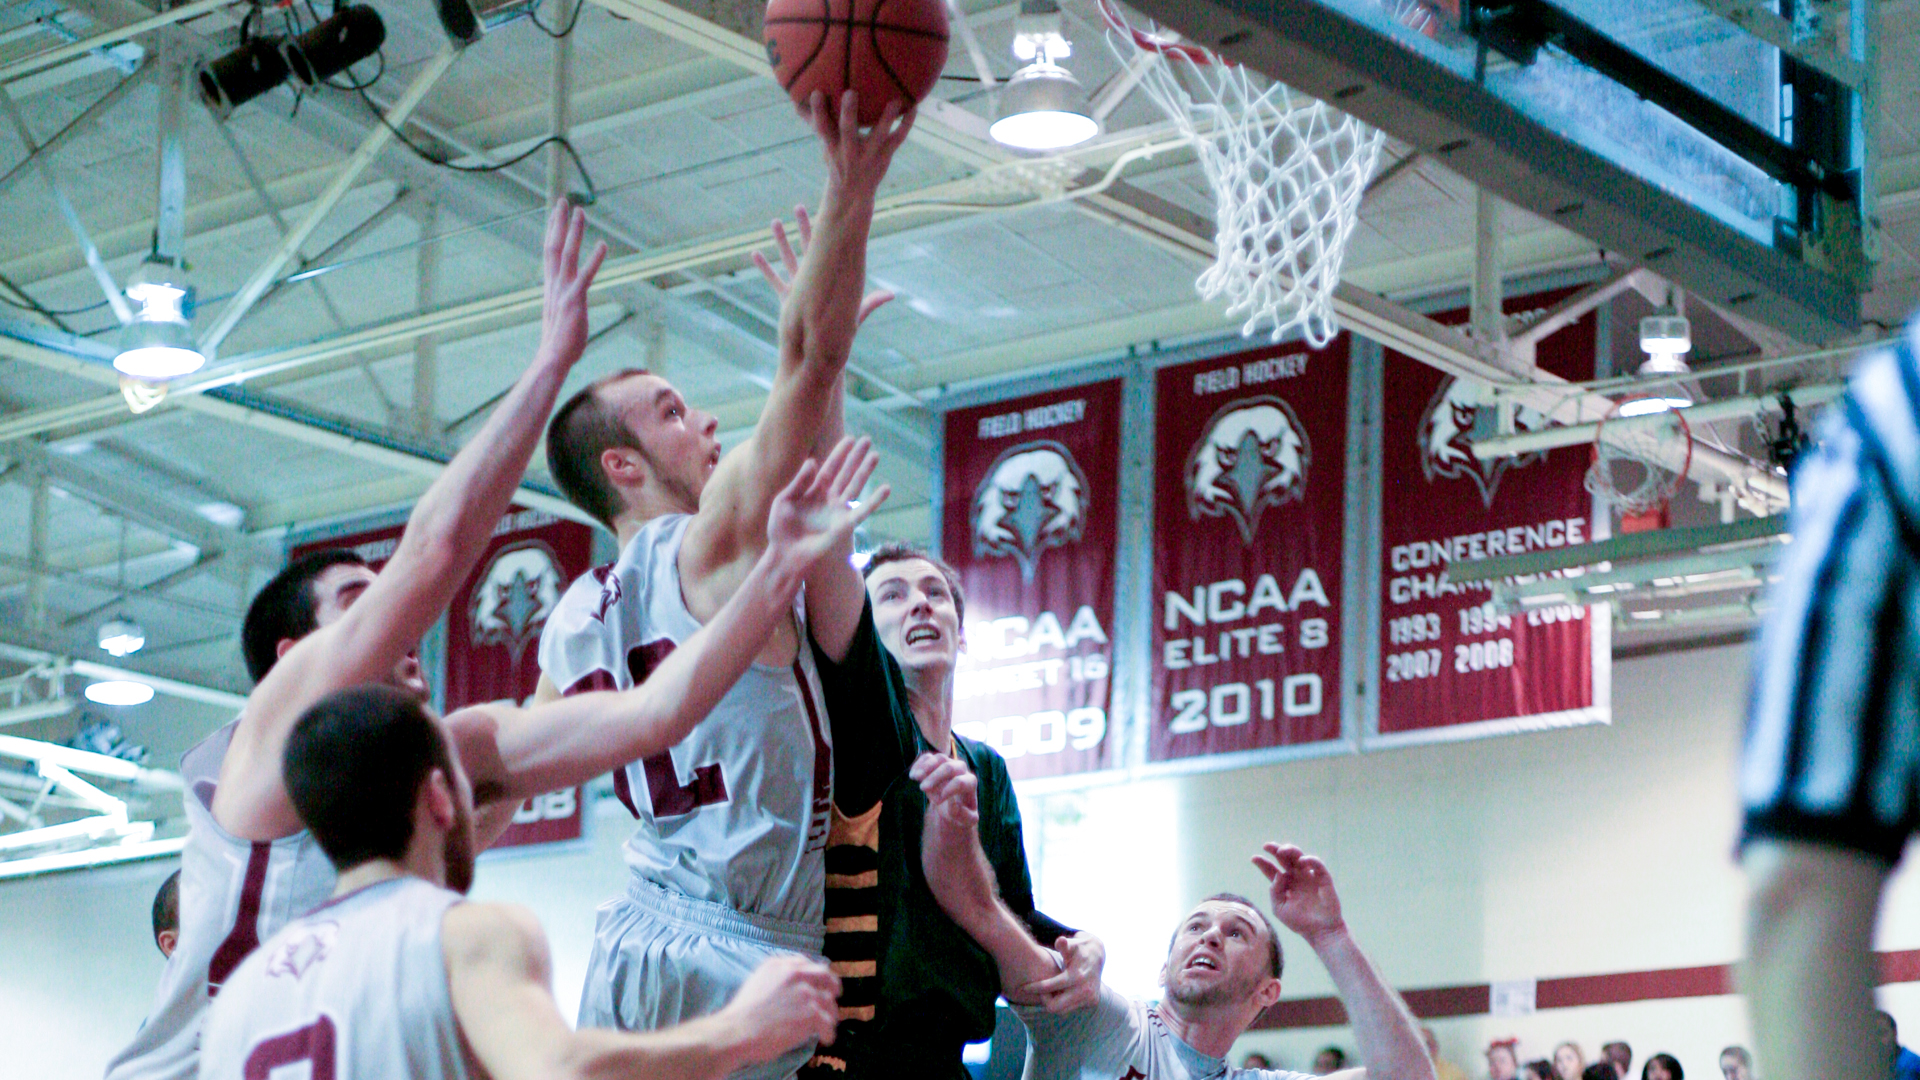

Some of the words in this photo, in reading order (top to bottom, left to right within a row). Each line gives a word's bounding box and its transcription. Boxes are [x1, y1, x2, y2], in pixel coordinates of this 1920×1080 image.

[1193, 366, 1240, 396] FIELD
[1242, 352, 1309, 385] HOCKEY
[1391, 517, 1585, 571] CONFERENCE
[1164, 567, 1331, 631] NCAA
[1163, 623, 1285, 670] ELITE
[1300, 617, 1329, 649] 8
[1389, 612, 1441, 645] 1993
[1070, 653, 1108, 682] 16
[1386, 648, 1442, 683] 2007
[1454, 638, 1514, 674] 2008
[1168, 673, 1323, 735] 2010
